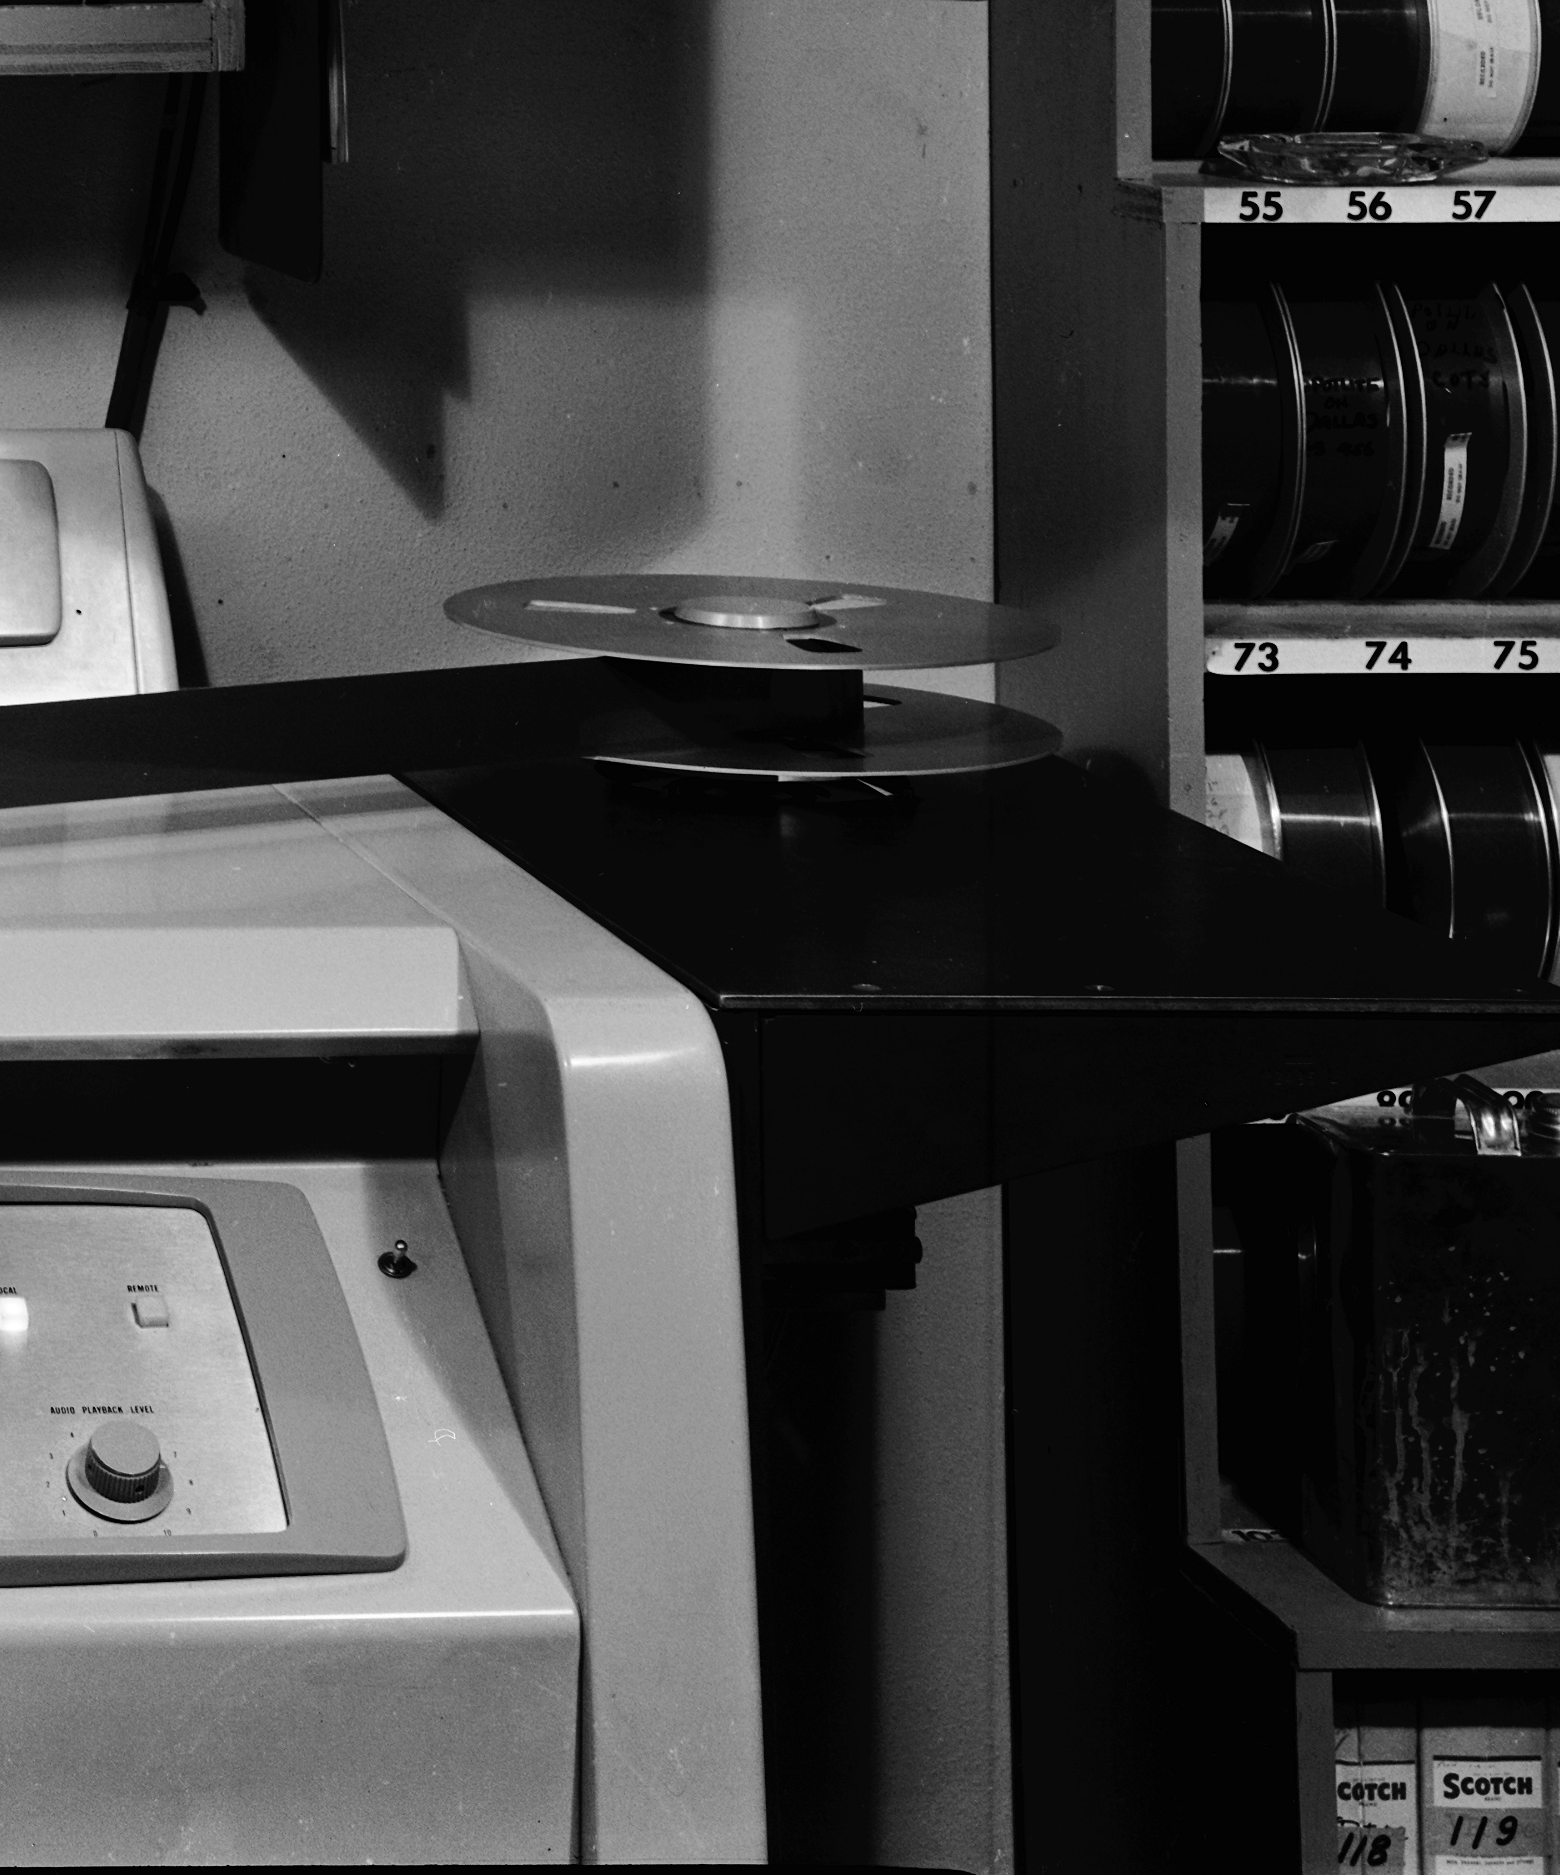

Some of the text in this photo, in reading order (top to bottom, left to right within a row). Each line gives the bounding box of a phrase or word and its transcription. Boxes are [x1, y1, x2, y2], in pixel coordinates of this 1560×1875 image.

[1239, 190, 1497, 221] 55 56 57
[1234, 640, 1539, 671] 73 74 75
[127, 1284, 160, 1293] REMOTE
[50, 1405, 154, 1414] AUDIO PLAYBACK LEVEL
[1337, 1781, 1407, 1801] COTCH
[1450, 1814, 1519, 1850] 119
[1337, 1831, 1392, 1867] 118
